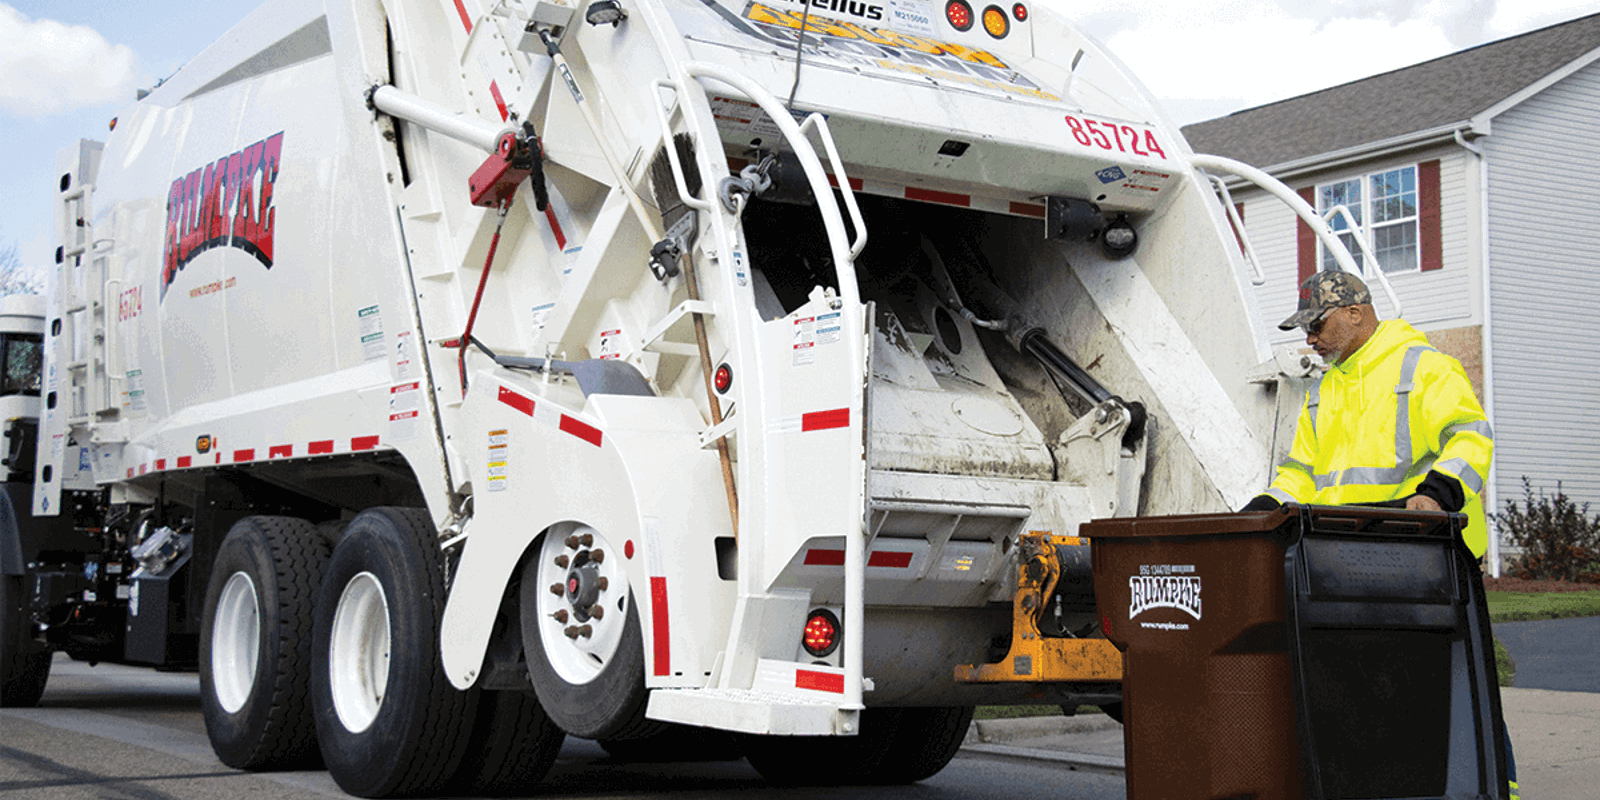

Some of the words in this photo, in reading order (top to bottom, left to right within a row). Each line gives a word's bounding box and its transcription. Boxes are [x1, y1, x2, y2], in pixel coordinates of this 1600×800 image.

[1064, 115, 1168, 160] 85724
[159, 130, 285, 306] RUMPKE
[118, 285, 142, 323] 85724
[188, 276, 237, 299] www.rumpke.com
[1129, 576, 1202, 620] RUMPKE
[1140, 622, 1190, 631] www.rumpke.com
